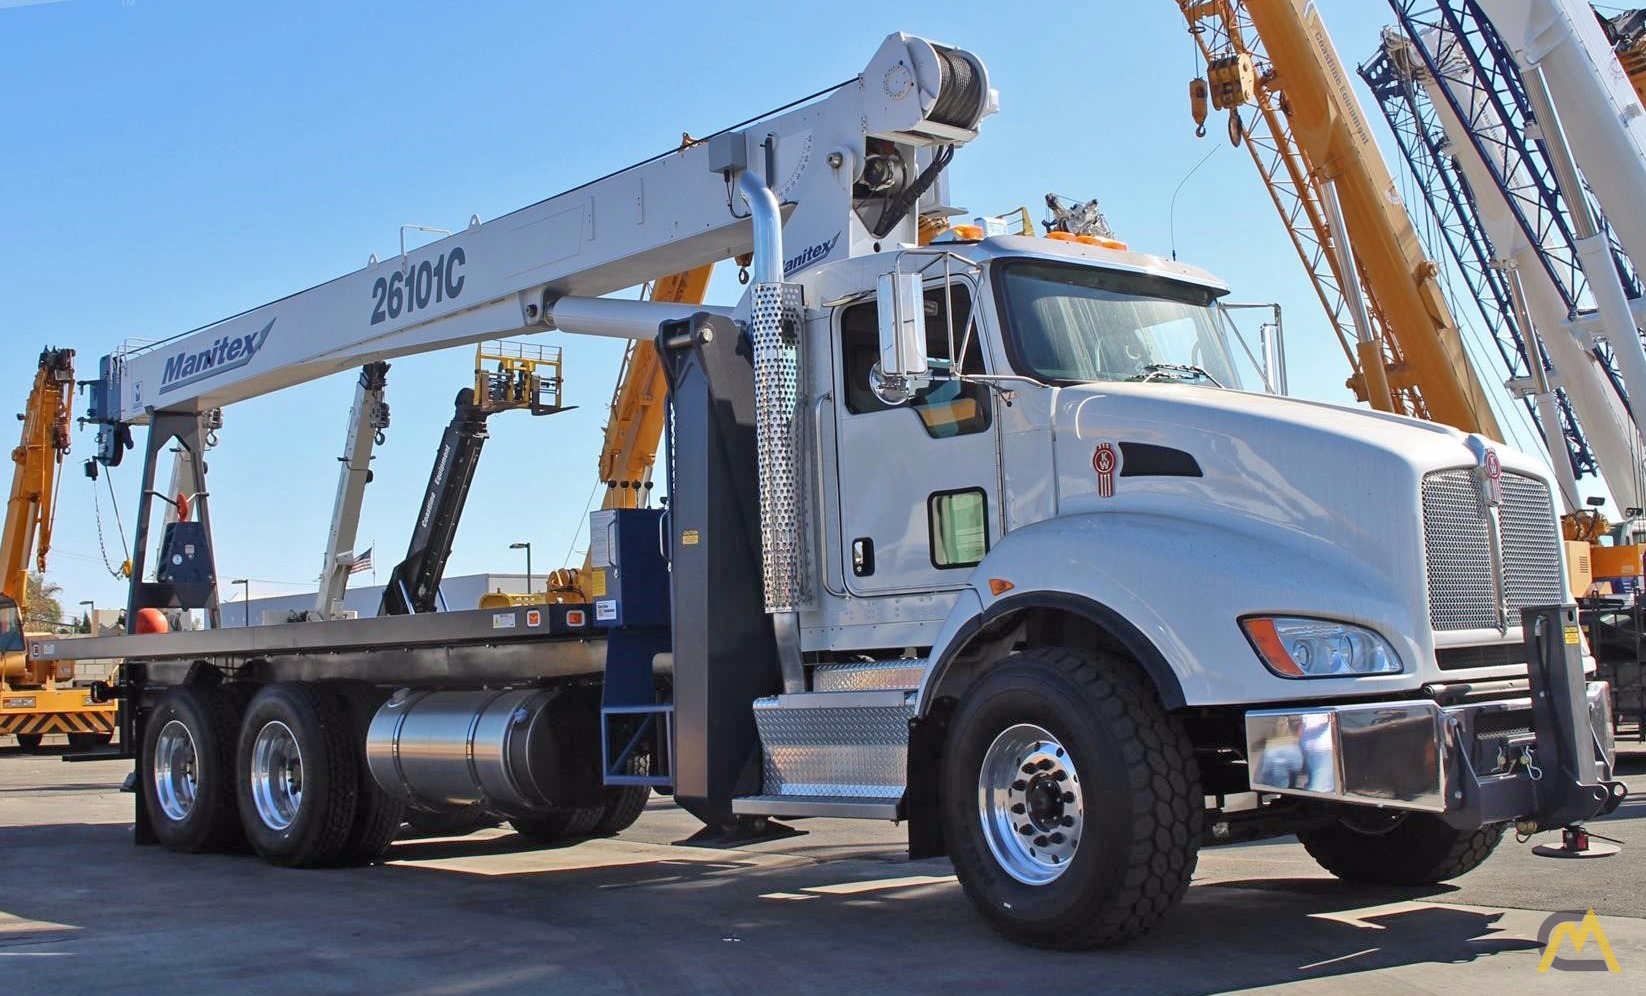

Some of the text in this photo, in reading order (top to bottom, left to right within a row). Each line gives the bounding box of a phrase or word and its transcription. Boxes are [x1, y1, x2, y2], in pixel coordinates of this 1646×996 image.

[783, 239, 831, 272] anitex
[370, 246, 467, 326] 26101C
[161, 331, 258, 385] Manitex
[434, 444, 450, 485] Equipment
